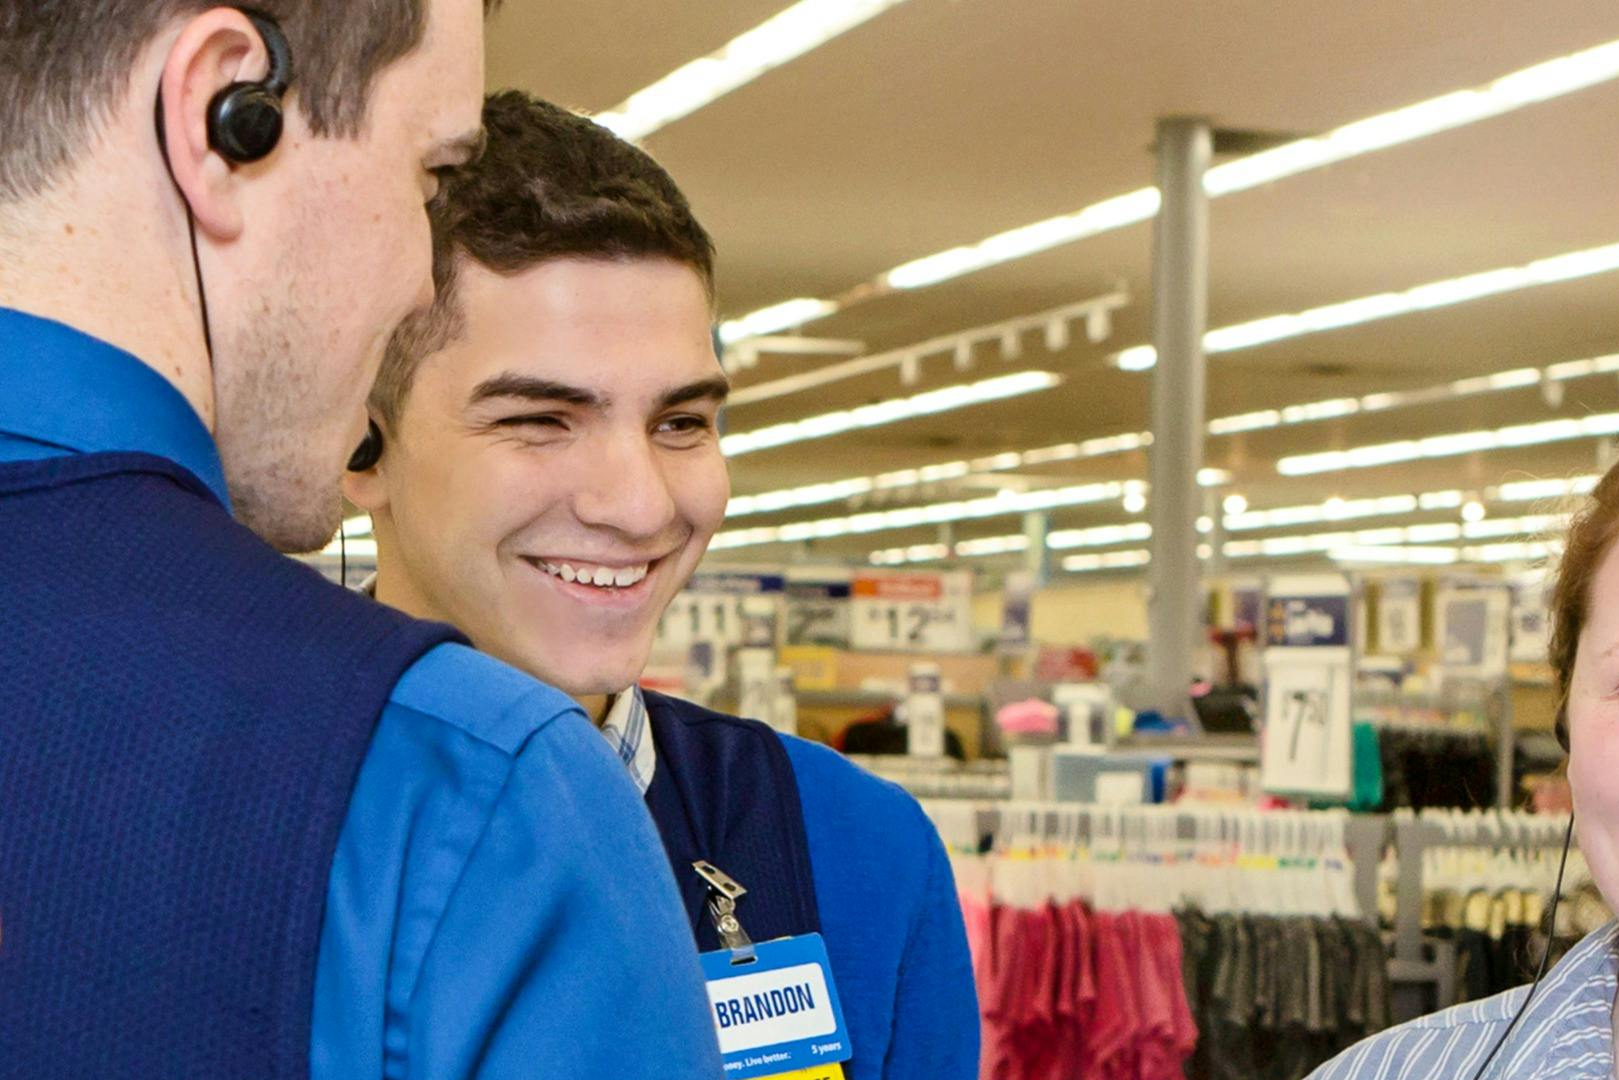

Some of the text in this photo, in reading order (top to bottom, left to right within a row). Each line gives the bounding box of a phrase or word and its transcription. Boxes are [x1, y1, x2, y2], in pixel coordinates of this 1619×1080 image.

[715, 982, 815, 1028] BRANDON
[819, 1041, 842, 1055] years
[745, 1057, 762, 1068] Live
